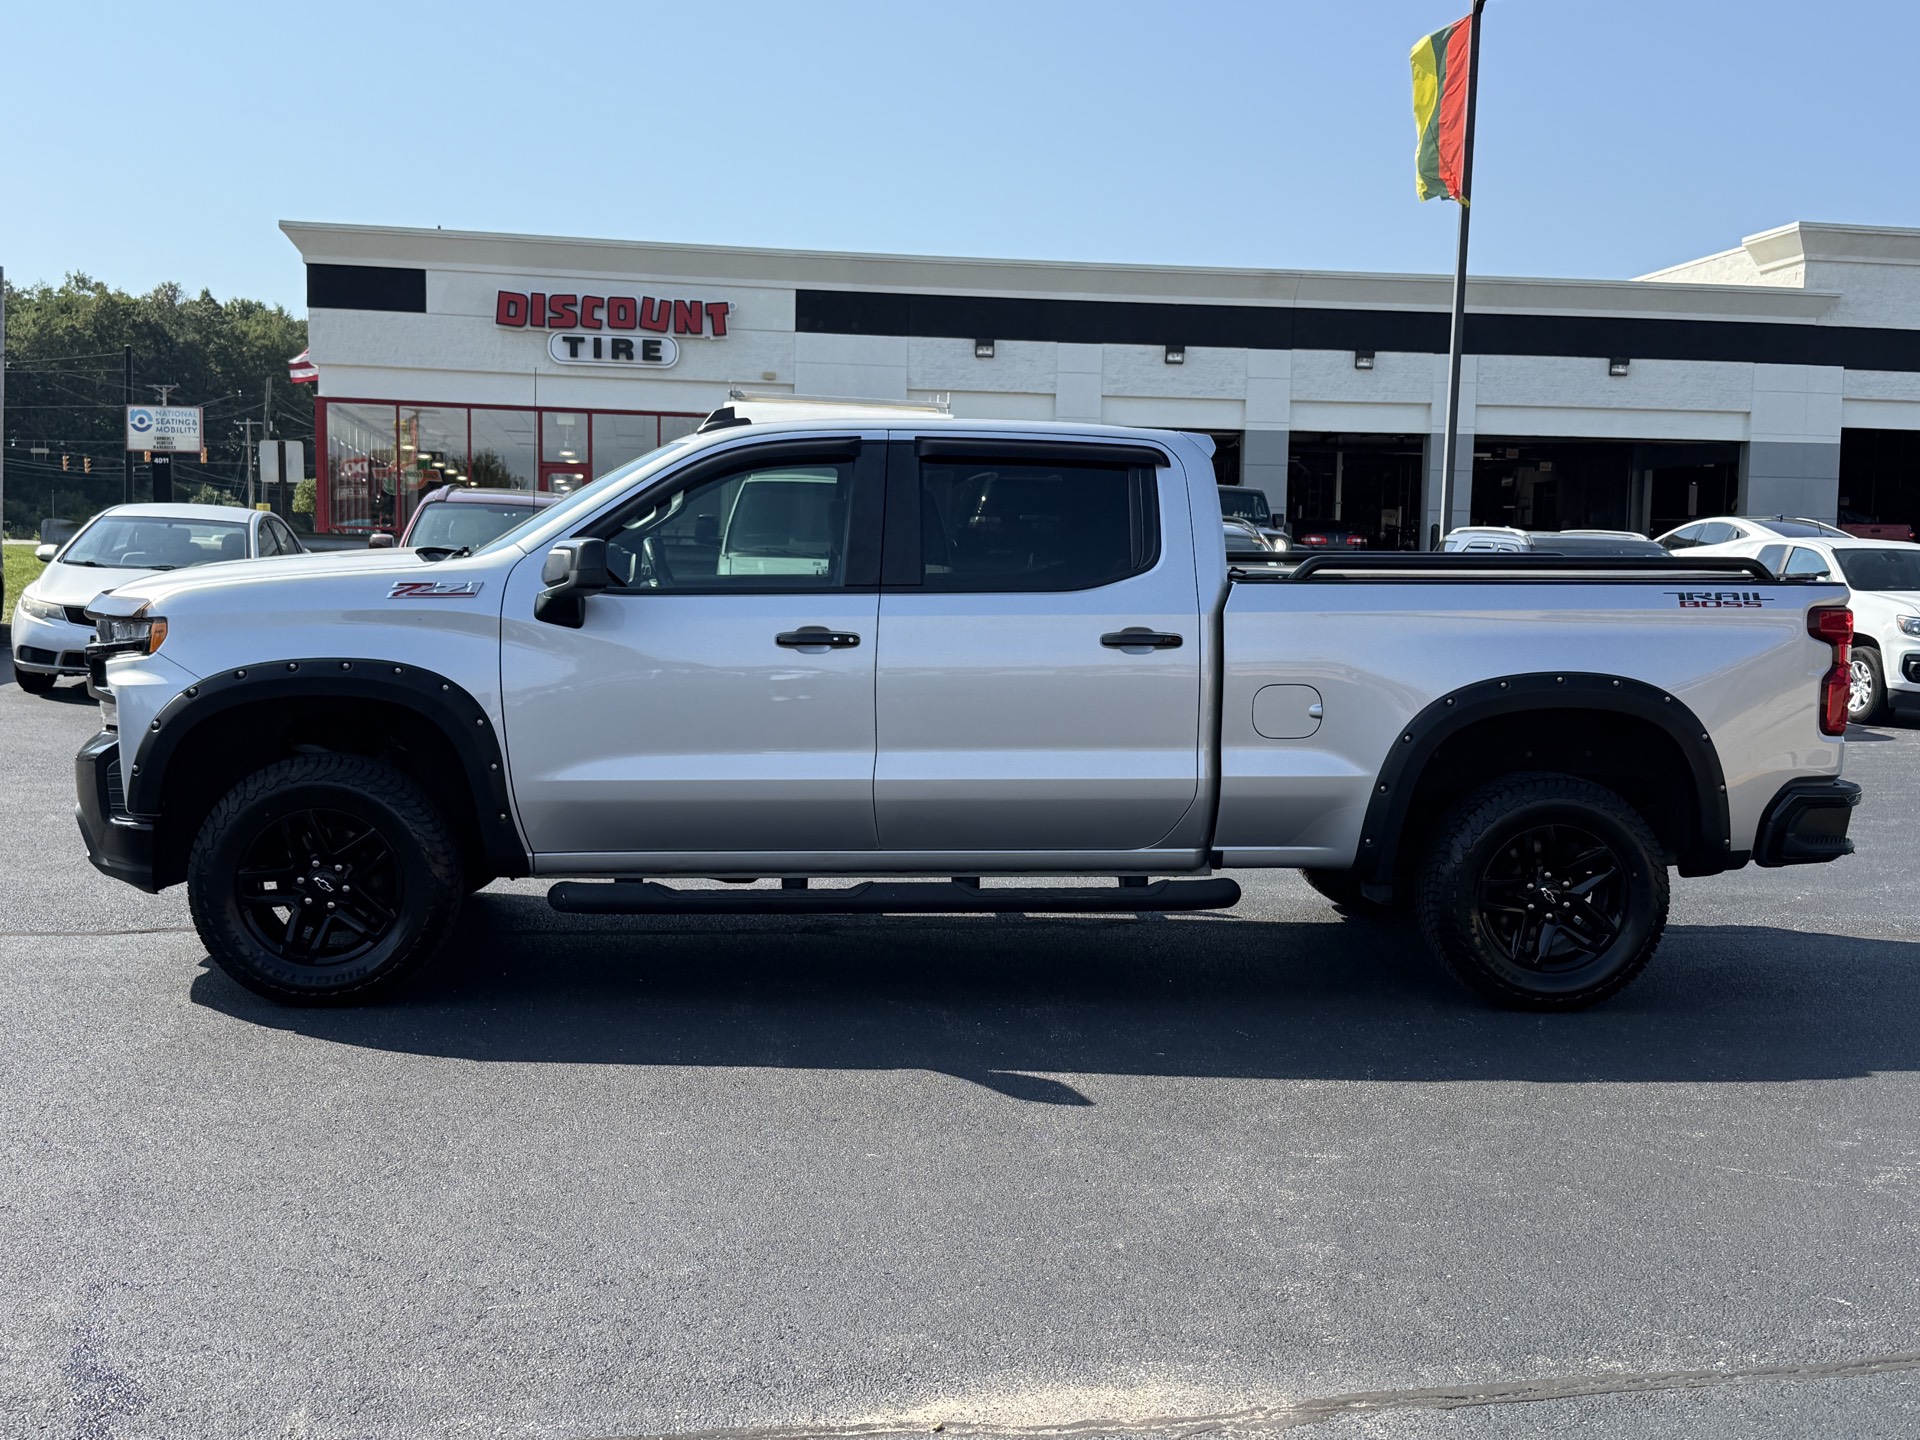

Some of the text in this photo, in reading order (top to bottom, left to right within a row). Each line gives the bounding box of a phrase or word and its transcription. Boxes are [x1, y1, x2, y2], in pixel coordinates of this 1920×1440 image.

[495, 290, 730, 336] DISCOUNT
[562, 336, 663, 362] TIRE
[155, 410, 198, 418] NATIONAL
[155, 418, 191, 426] SEATING
[155, 426, 198, 434] MOBILITY
[386, 581, 485, 599] Z71
[1662, 592, 1775, 601] TRAIL
[1679, 600, 1763, 608] BOSS
[244, 950, 369, 986] RIDGETRAK
